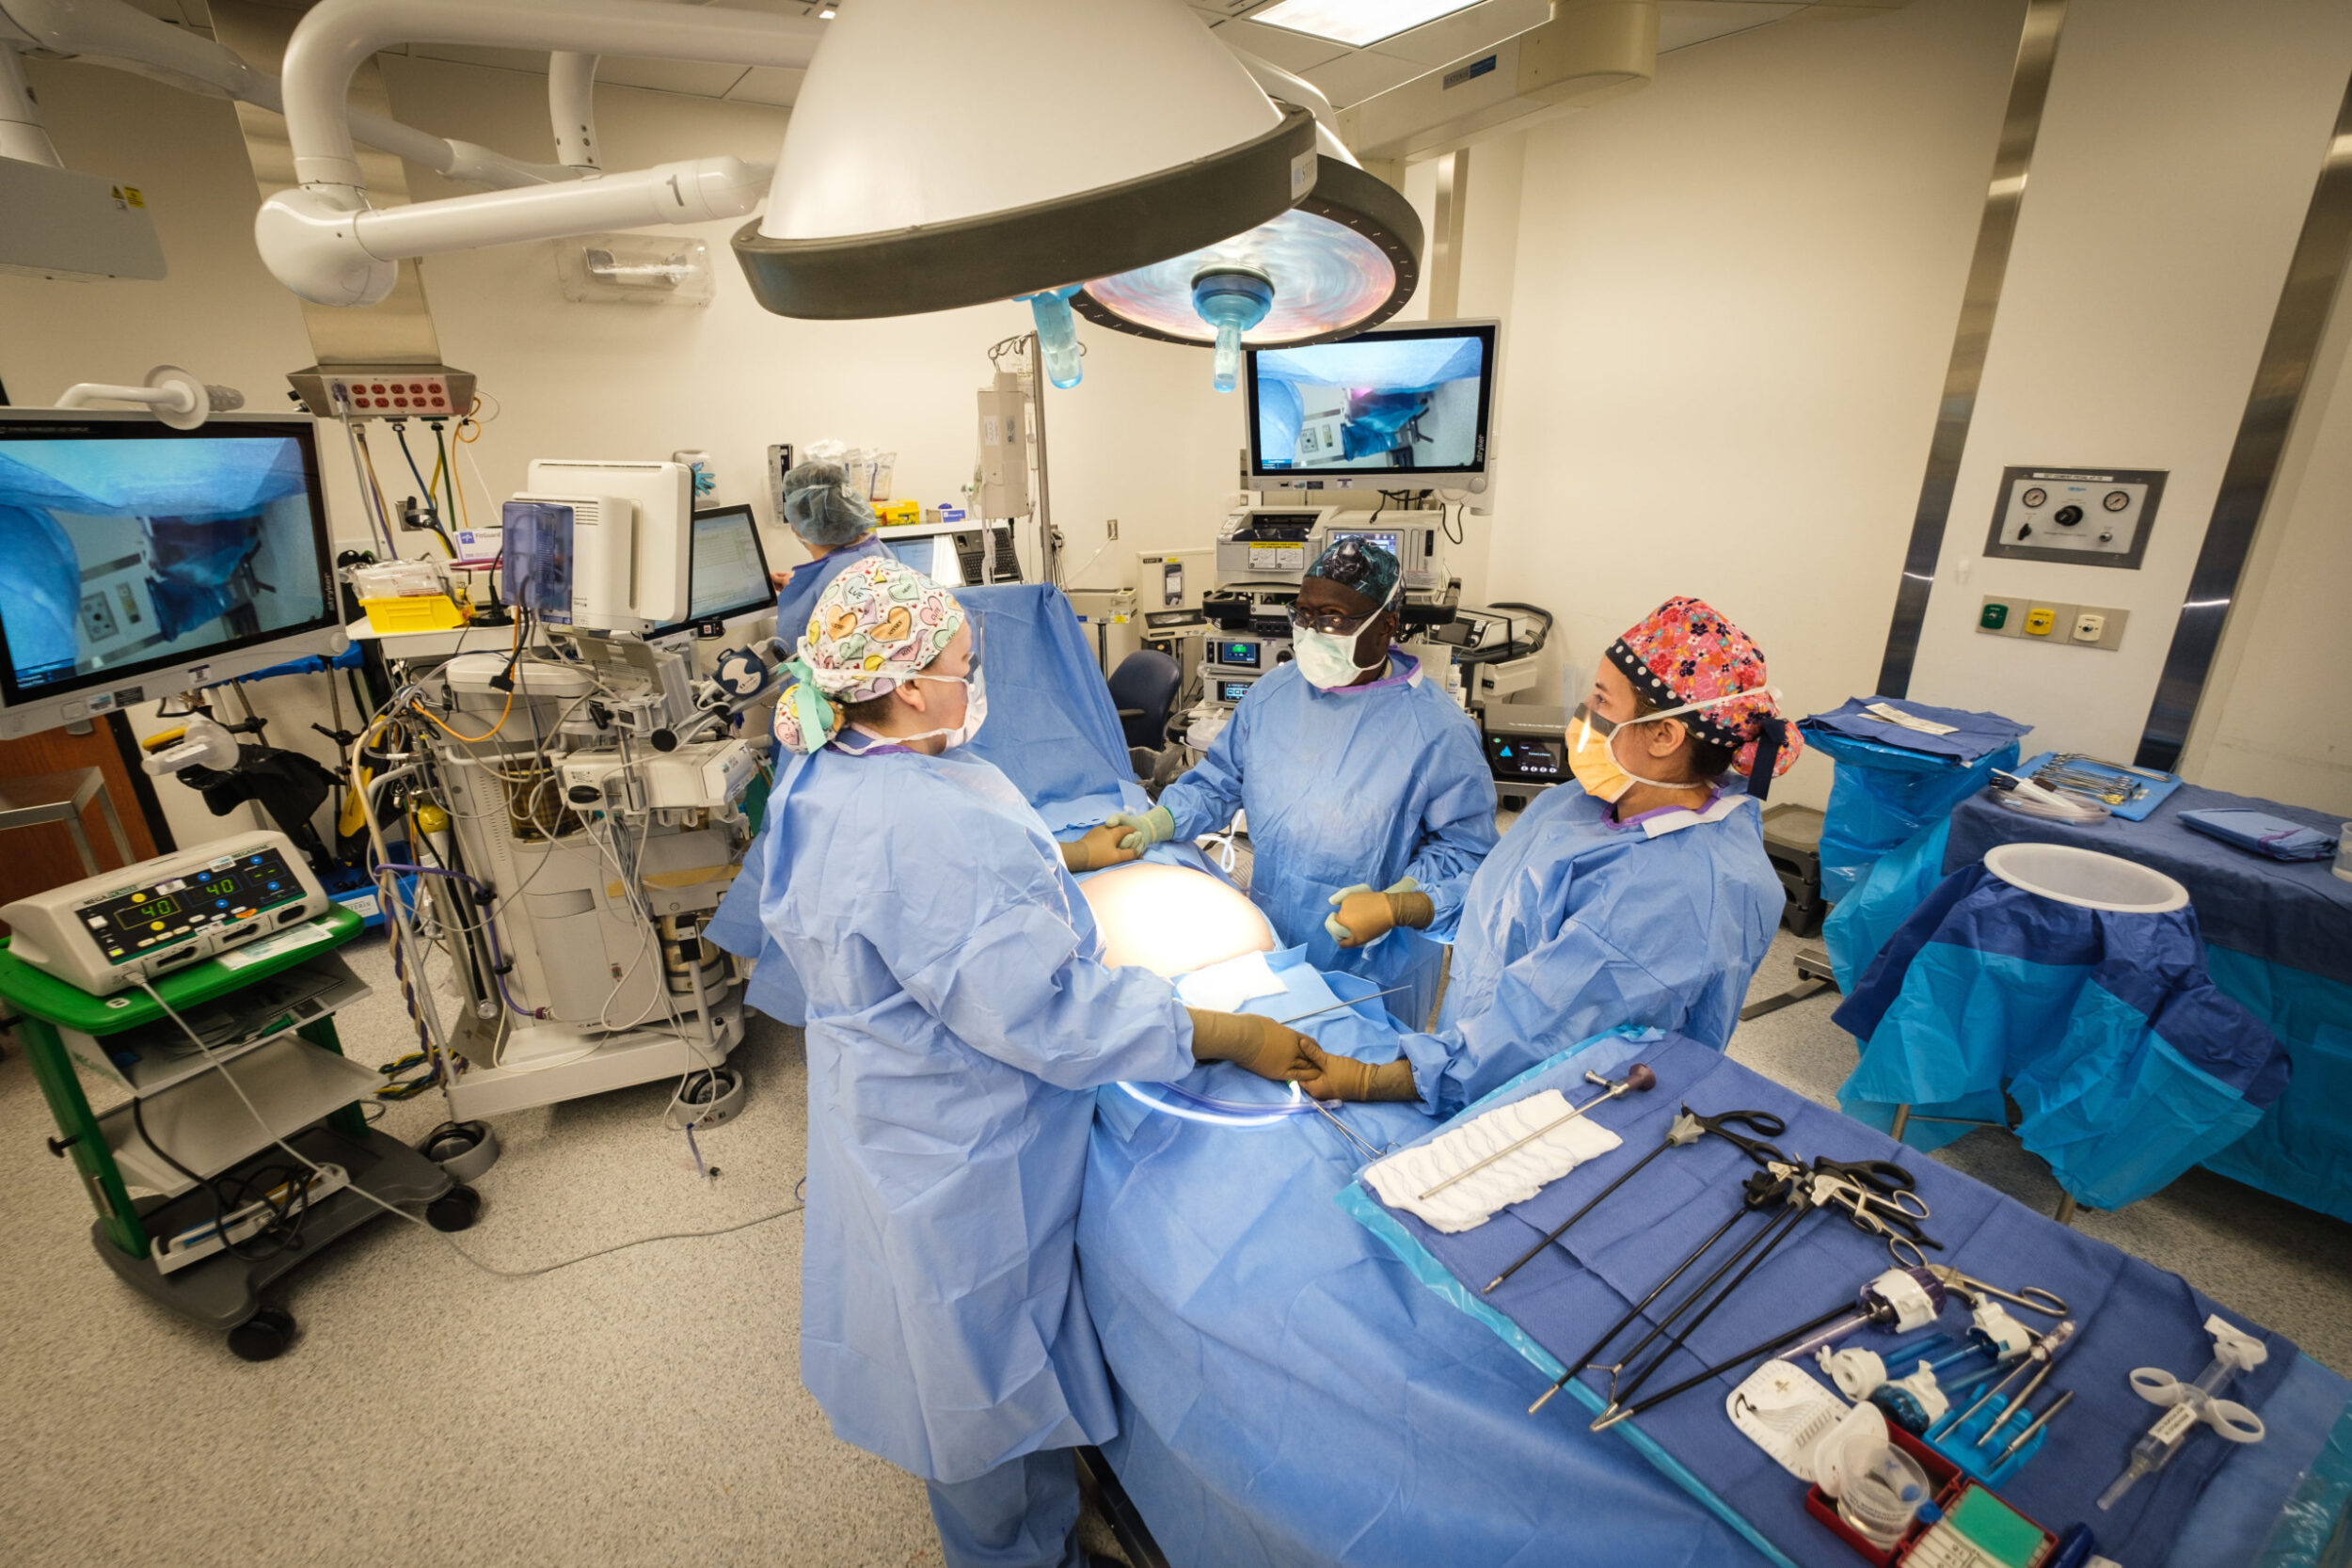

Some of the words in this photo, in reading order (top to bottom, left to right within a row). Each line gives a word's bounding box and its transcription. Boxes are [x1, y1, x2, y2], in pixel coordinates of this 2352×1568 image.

[325, 572, 335, 610] stryker
[204, 879, 234, 895] 40
[140, 900, 171, 917] 40
